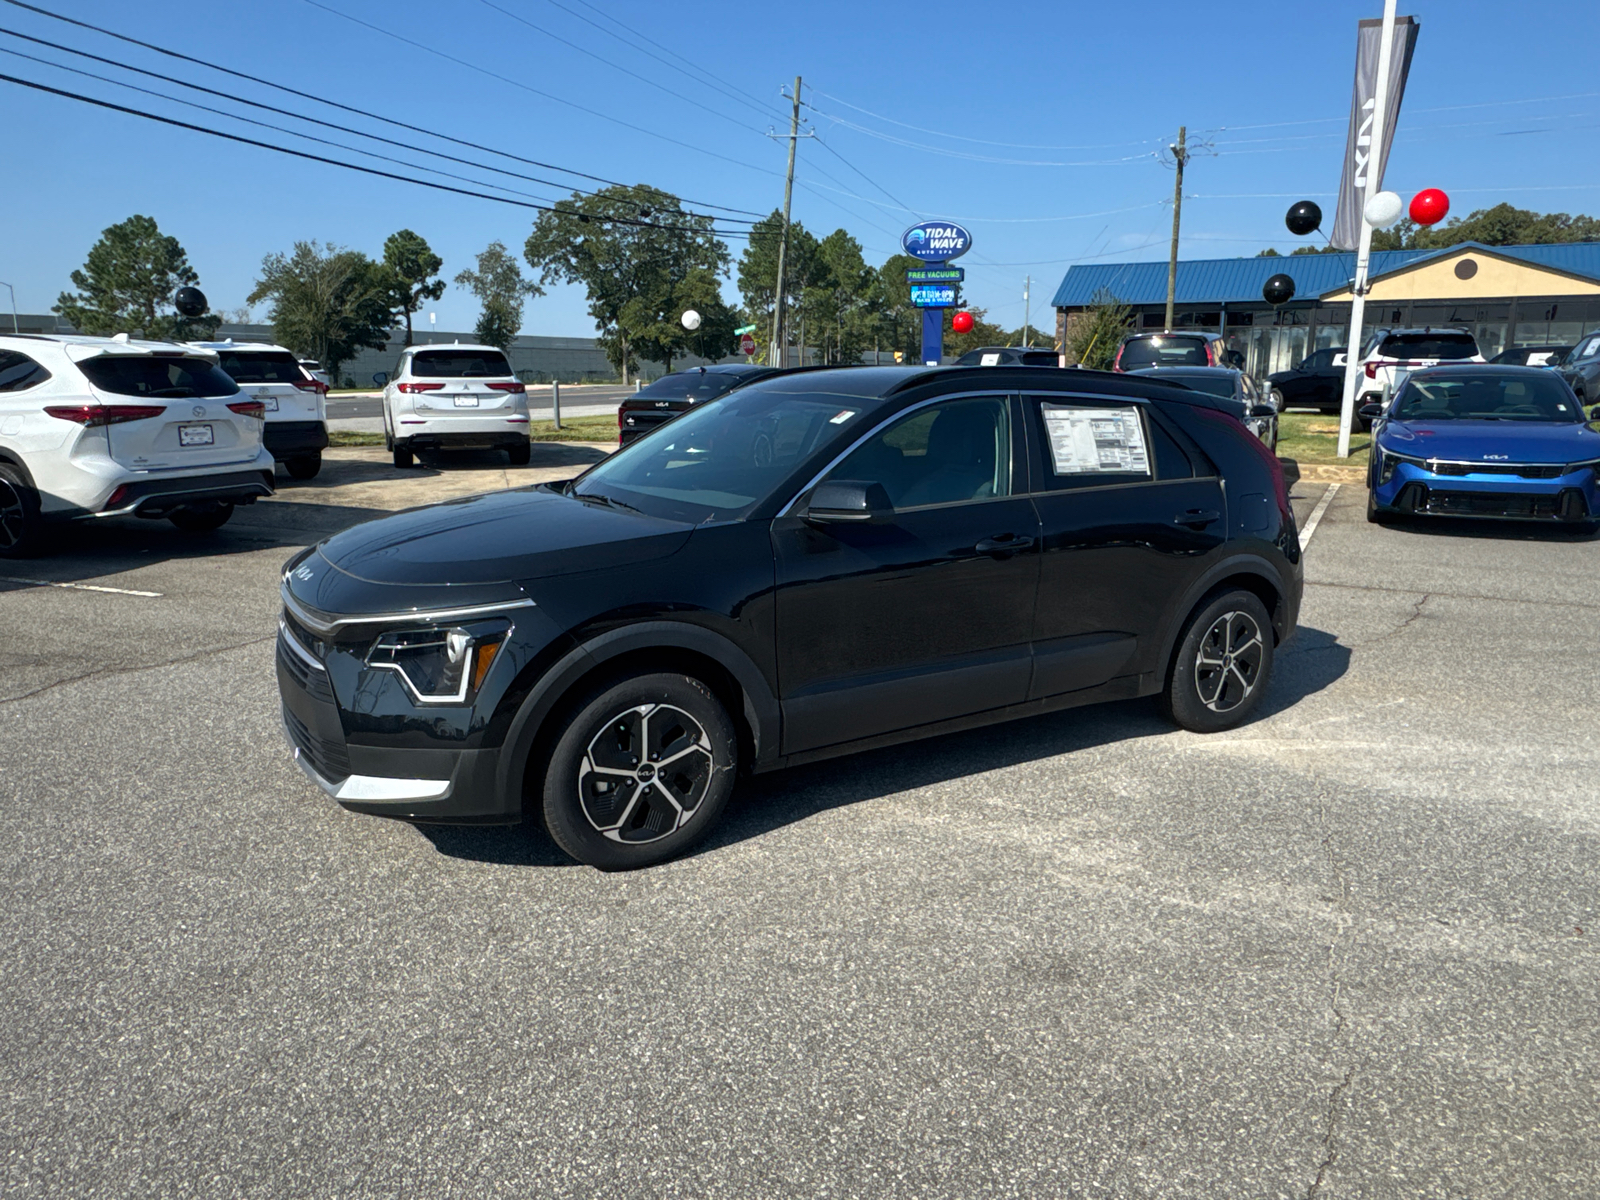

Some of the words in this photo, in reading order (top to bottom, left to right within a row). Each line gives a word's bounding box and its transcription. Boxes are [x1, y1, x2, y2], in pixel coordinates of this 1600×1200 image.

[926, 228, 957, 238] TIDAL
[930, 238, 964, 248] WAVE
[908, 271, 926, 279] FREE
[927, 270, 960, 278] VACUUMS
[295, 564, 314, 581] KIA
